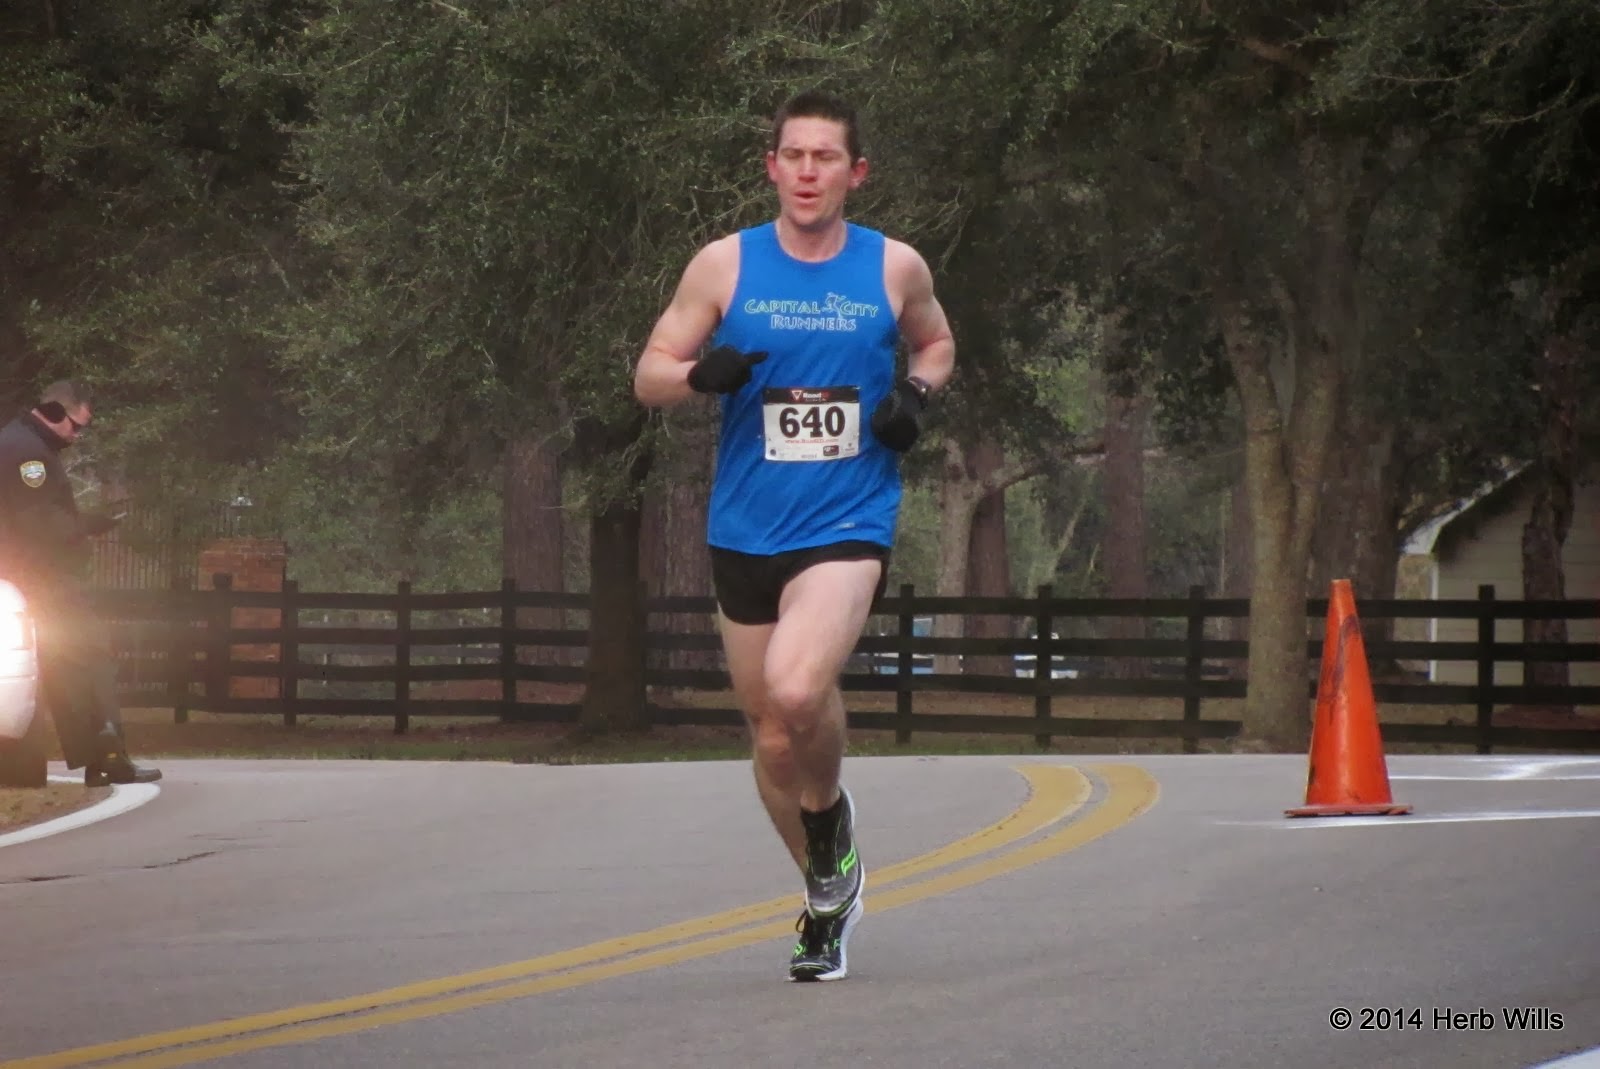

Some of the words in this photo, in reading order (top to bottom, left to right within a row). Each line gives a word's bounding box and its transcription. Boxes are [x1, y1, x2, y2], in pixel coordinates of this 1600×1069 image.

[744, 298, 821, 315] CAPITAL
[840, 300, 879, 318] CITY
[770, 314, 857, 332] RUNNERS
[779, 406, 846, 438] 640
